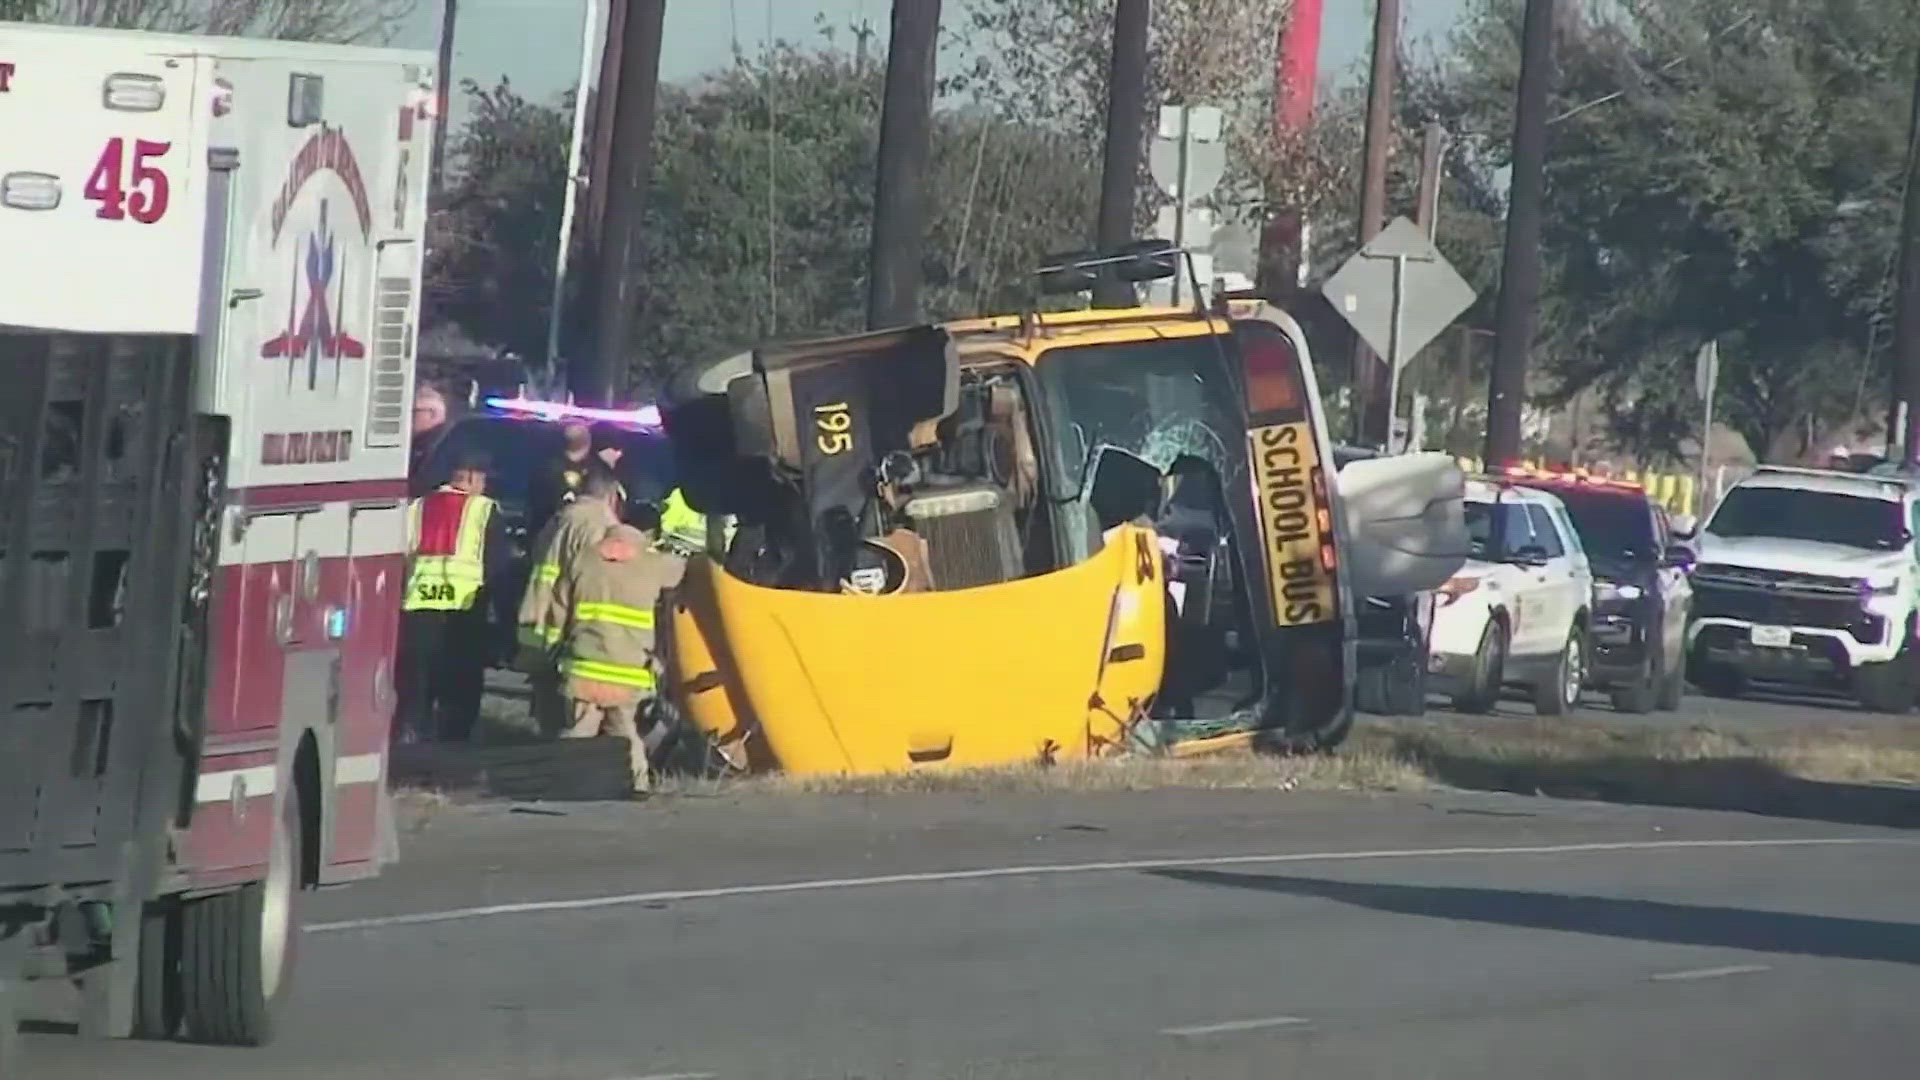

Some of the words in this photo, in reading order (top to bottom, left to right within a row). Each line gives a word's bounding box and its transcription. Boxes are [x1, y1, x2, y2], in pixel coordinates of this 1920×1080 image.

[84, 137, 171, 224] 45
[814, 402, 853, 454] 195
[1261, 426, 1310, 552] SCHOOL
[1280, 561, 1321, 623] BUS
